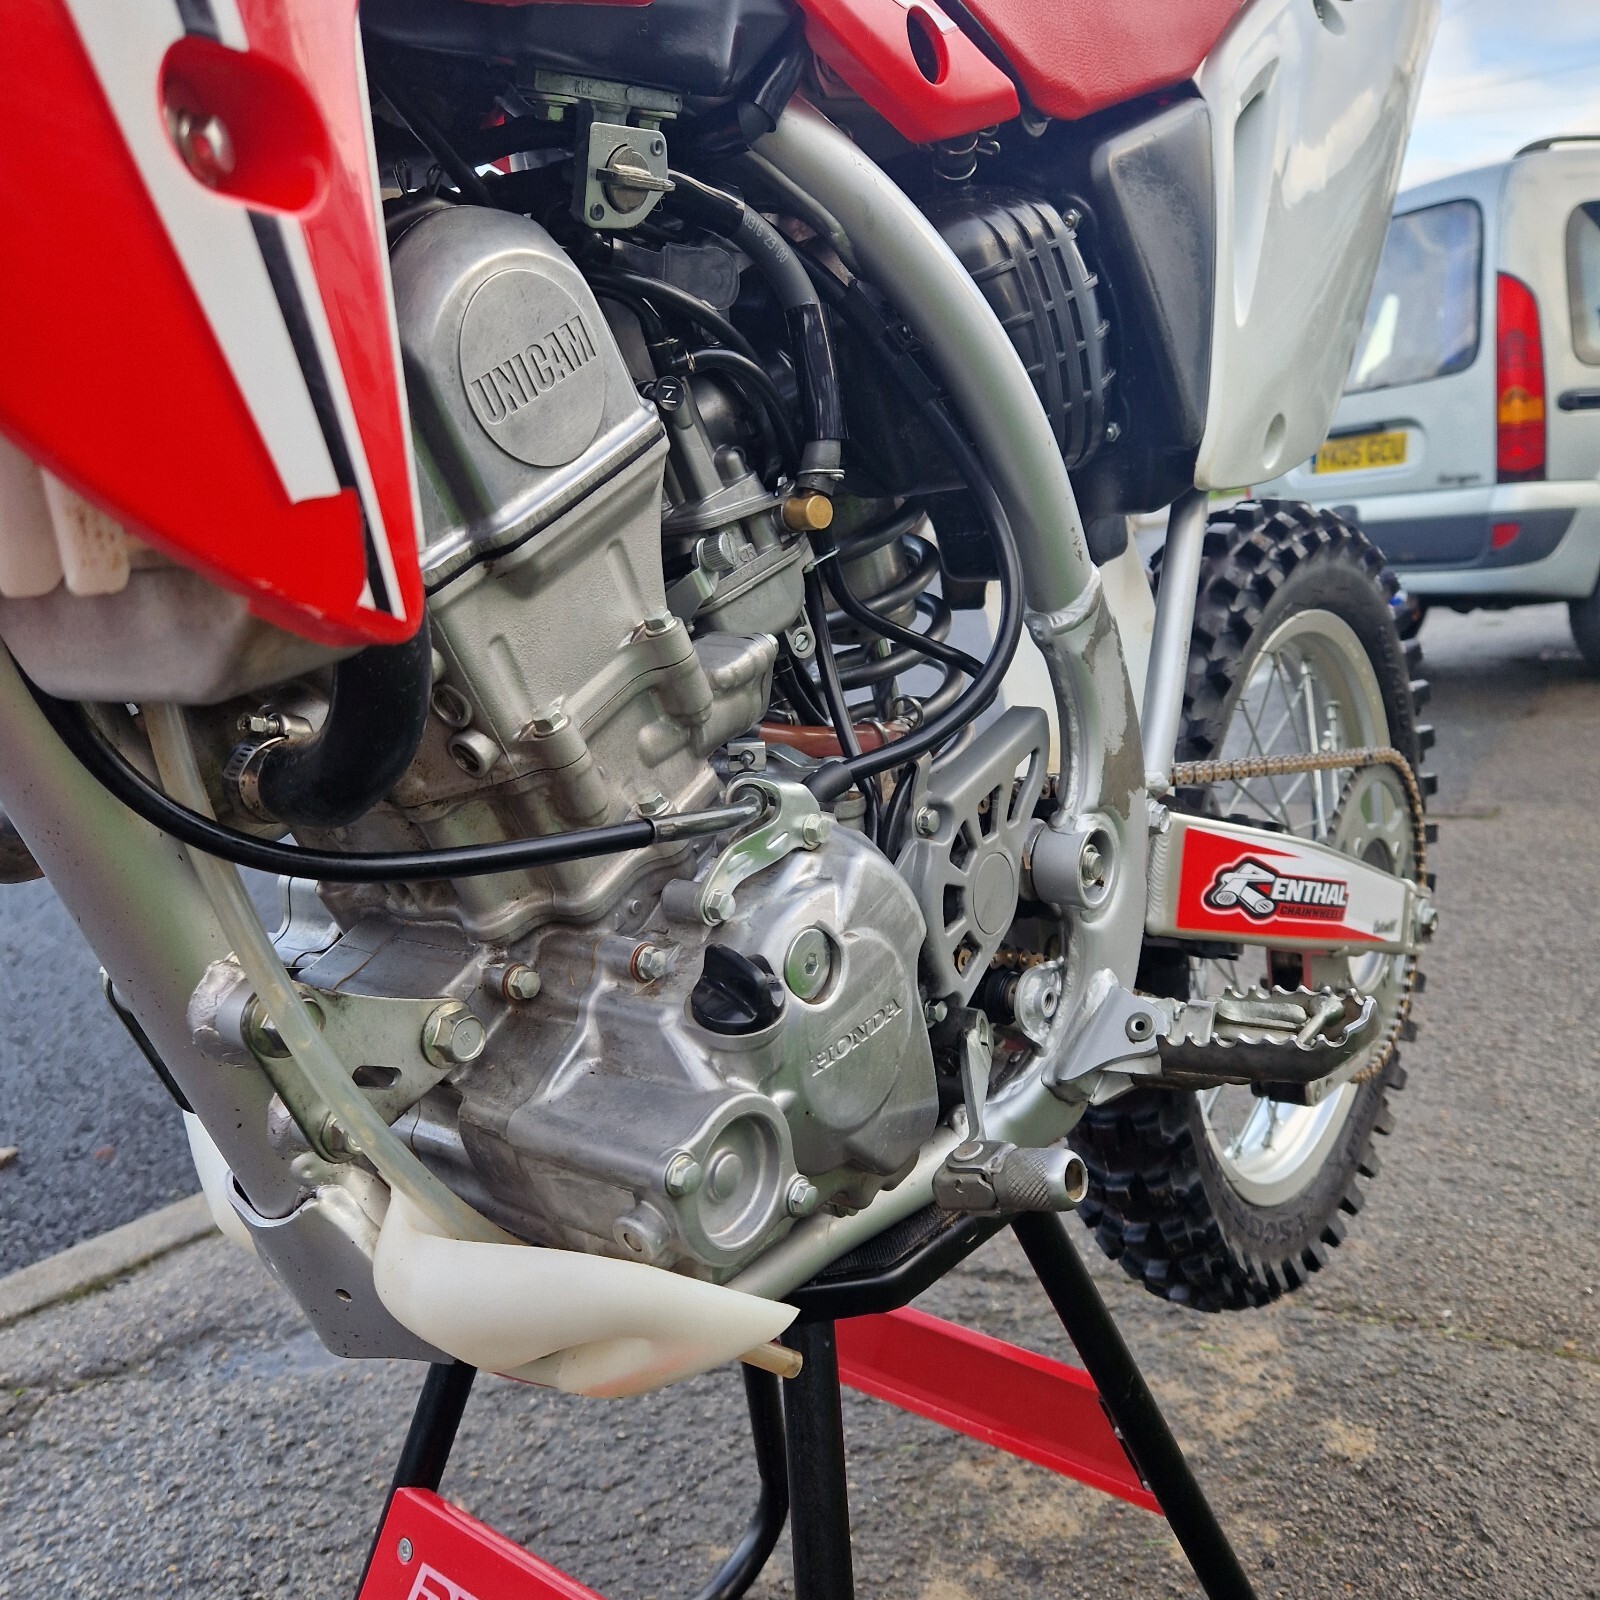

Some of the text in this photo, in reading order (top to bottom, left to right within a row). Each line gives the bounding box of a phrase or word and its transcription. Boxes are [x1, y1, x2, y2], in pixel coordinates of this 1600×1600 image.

[470, 314, 598, 426] UNICAM
[1279, 904, 1345, 920] CHAINWHEELS
[809, 998, 904, 1078] HONDA
